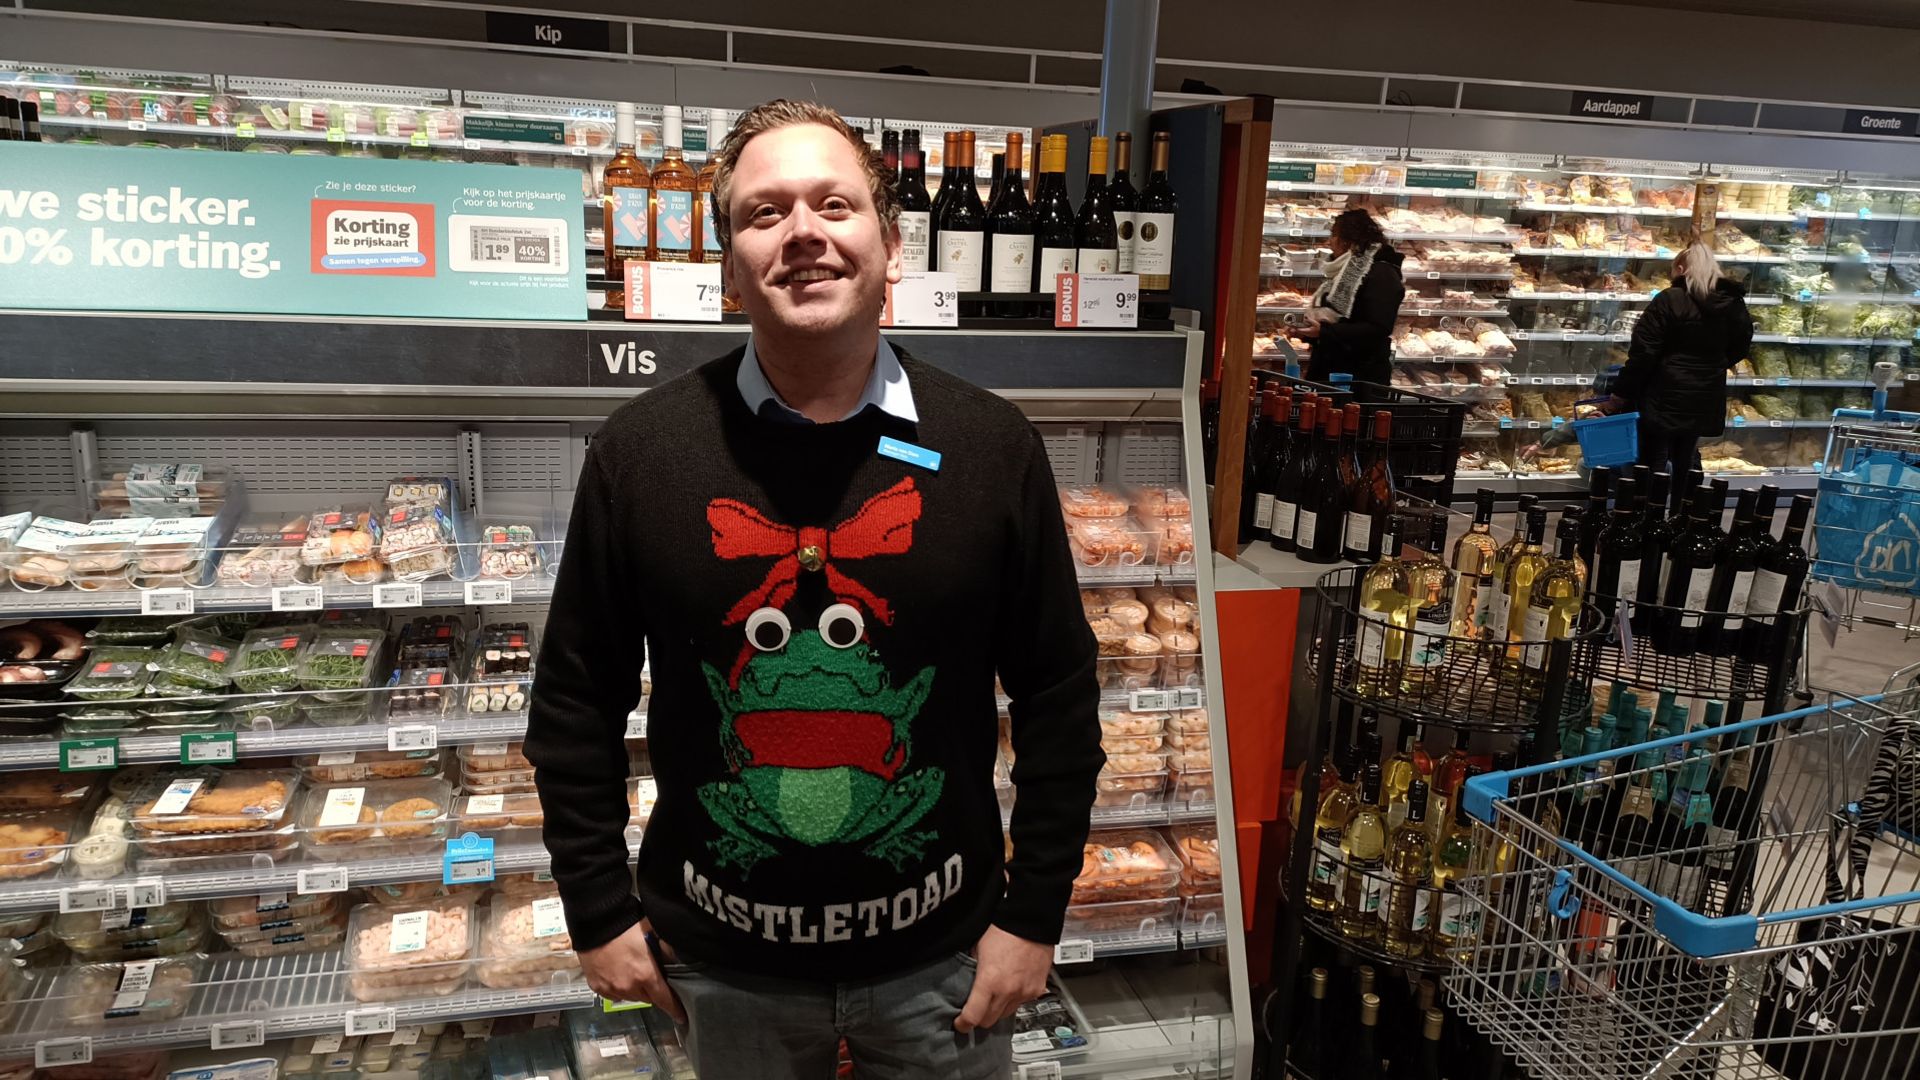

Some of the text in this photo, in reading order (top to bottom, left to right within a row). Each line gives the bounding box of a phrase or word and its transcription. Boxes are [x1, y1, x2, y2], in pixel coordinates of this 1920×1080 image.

[535, 25, 562, 45] Kip
[1583, 98, 1641, 116] Aardappel
[1861, 115, 1901, 130] Groente
[325, 181, 417, 193] Zie je deze sticker?
[463, 187, 566, 201] Kijk op het prijskaartje
[77, 185, 256, 226] sticker.
[463, 199, 535, 211] voor de korting.
[334, 217, 410, 238] Korting
[334, 236, 409, 248] zie prijskaart
[518, 246, 545, 256] 40%
[90, 227, 281, 279] korting.
[380, 255, 421, 265] verspilling.
[632, 266, 644, 315] BONUS
[696, 284, 720, 302] 7.99
[934, 290, 956, 308] 3.99
[1062, 277, 1073, 323] BONUS
[1116, 292, 1137, 309] 9.99
[600, 341, 657, 375] Vis
[683, 852, 963, 944] MISTLETOAD
